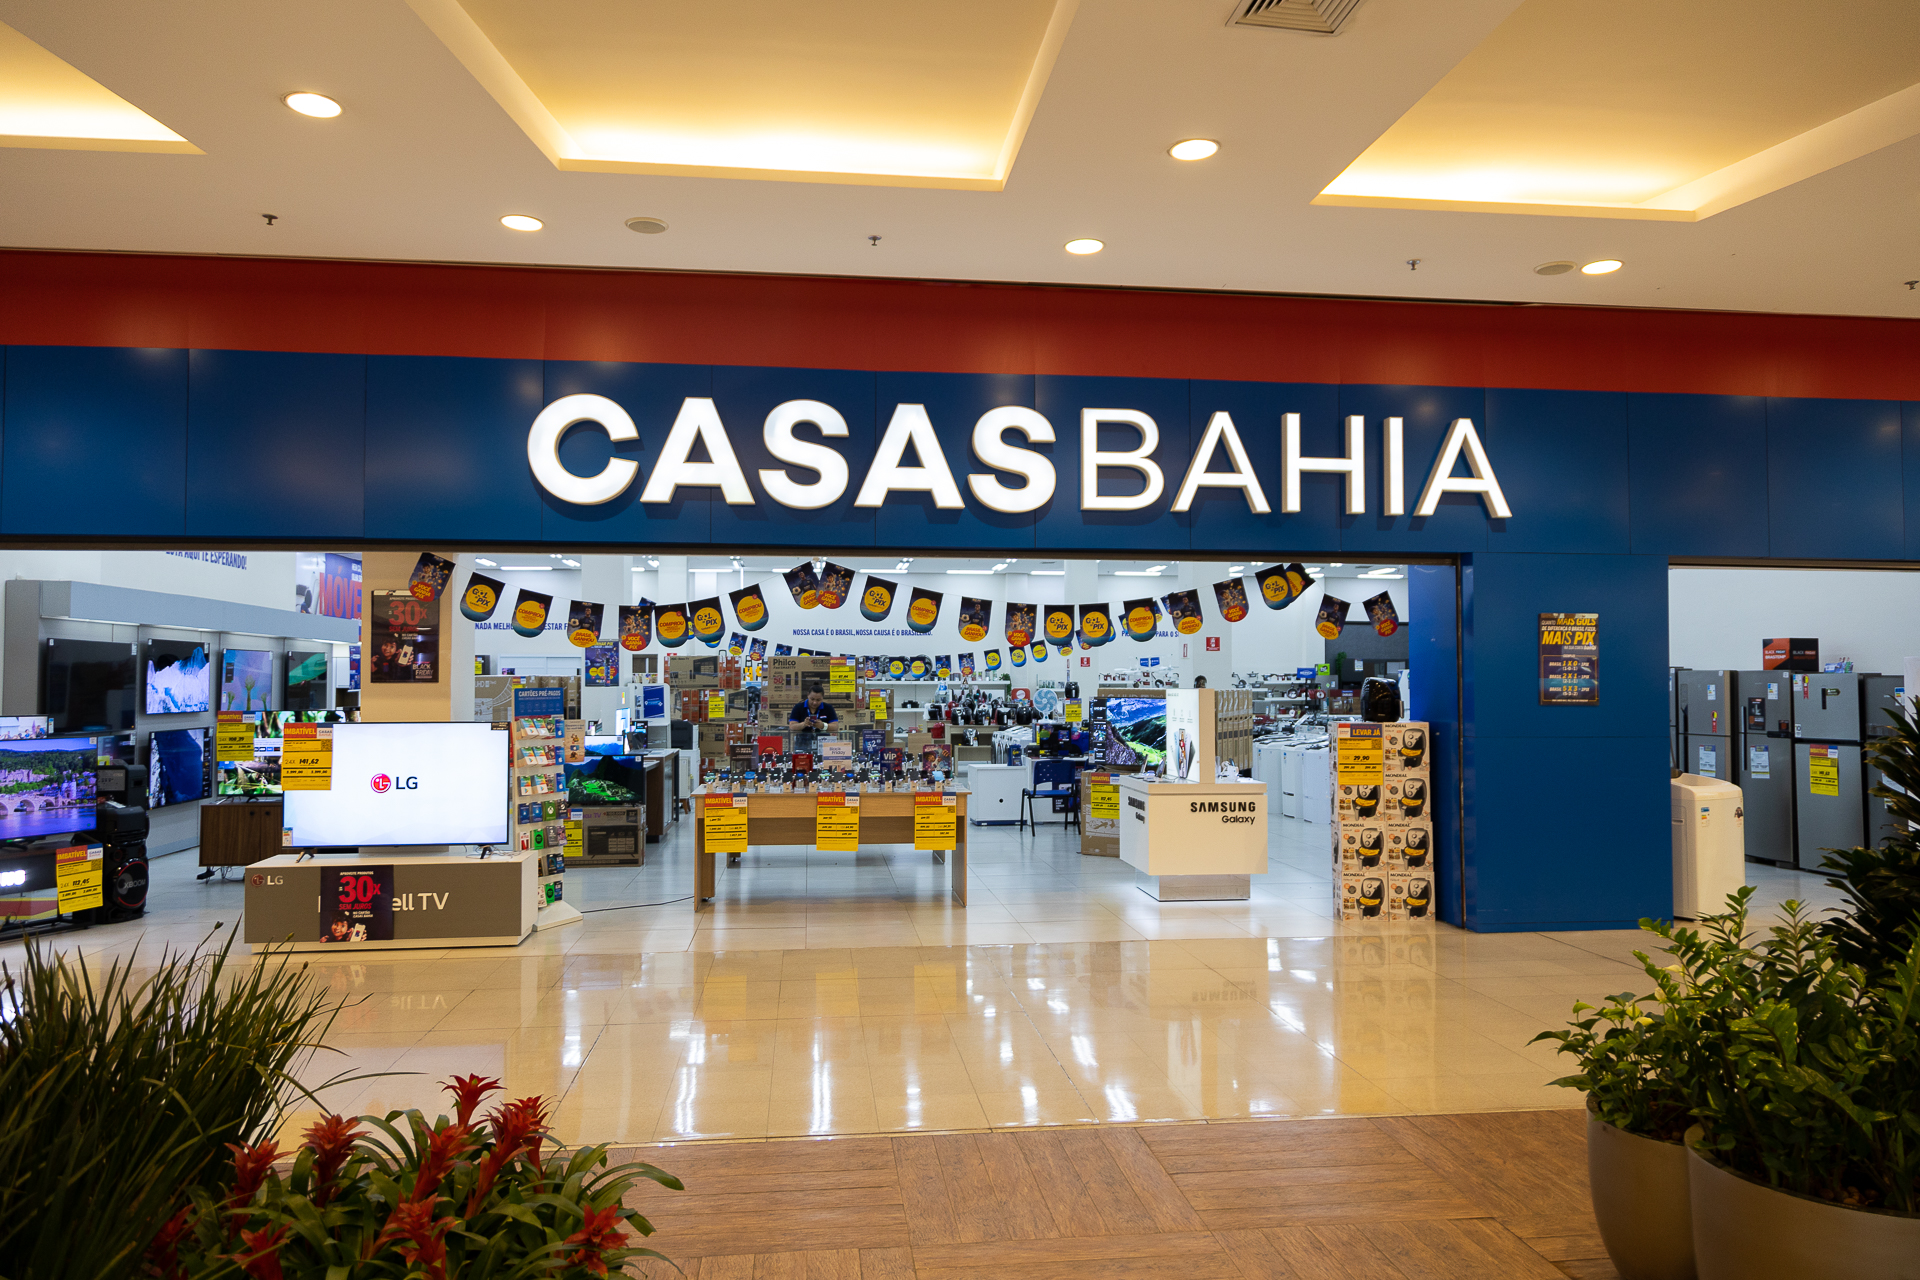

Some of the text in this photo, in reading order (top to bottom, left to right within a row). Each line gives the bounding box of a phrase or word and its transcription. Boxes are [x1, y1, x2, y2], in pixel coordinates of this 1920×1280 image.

[210, 552, 248, 570] ESPERANDO!
[518, 608, 544, 618] COMPROU
[739, 603, 762, 614] COMPROU
[912, 605, 936, 615] COMPROU
[892, 628, 895, 636] É
[1542, 631, 1596, 645] MAIS PIX
[396, 776, 418, 790] LG
[1190, 802, 1256, 812] SAMSUNG
[1222, 815, 1255, 825] Galaxy
[57, 850, 87, 860] IMBATÍVEL
[267, 876, 284, 885] LG
[417, 893, 449, 911] TV
